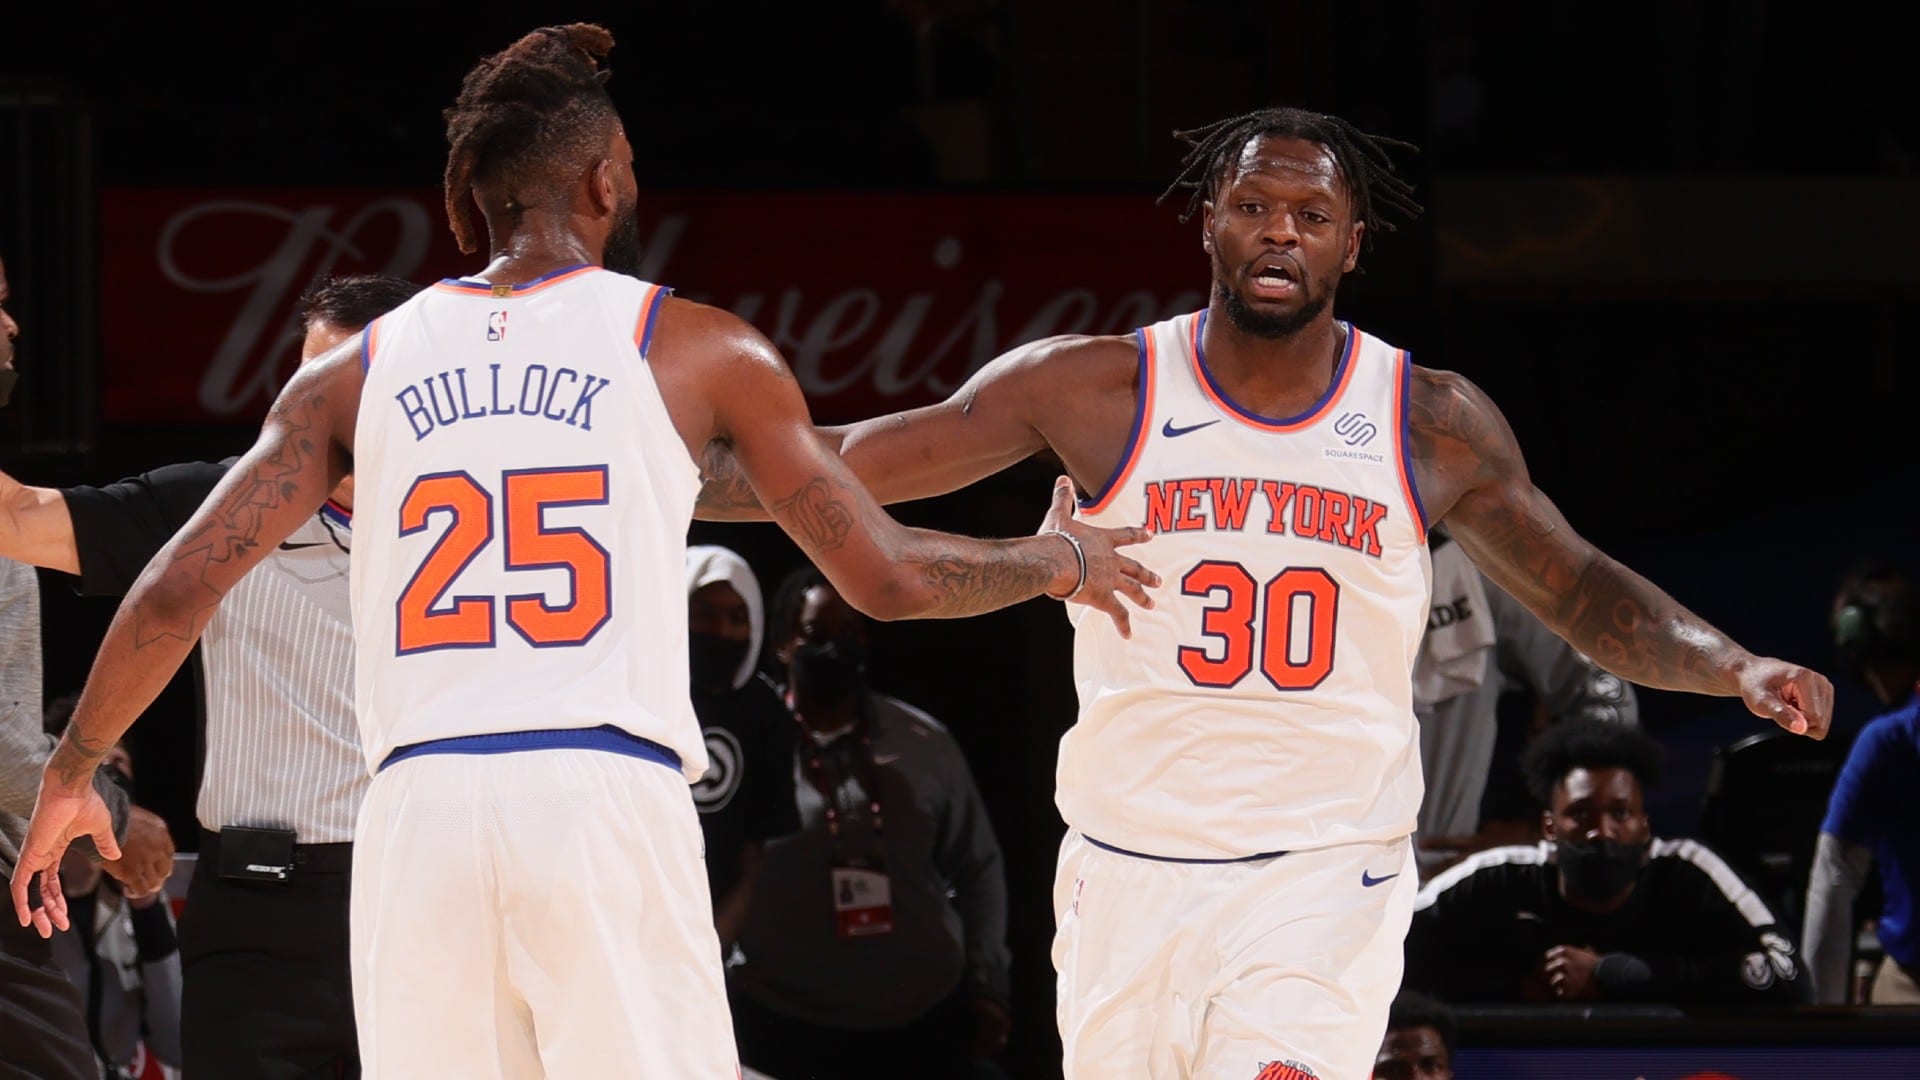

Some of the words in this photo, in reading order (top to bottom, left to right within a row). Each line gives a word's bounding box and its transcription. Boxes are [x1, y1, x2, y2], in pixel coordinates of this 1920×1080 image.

[395, 363, 609, 441] BULLOCK
[1324, 448, 1384, 463] SQUARESPACE
[1143, 477, 1257, 533] NEW
[1262, 479, 1388, 559] YORK
[396, 464, 611, 655] 25
[1177, 559, 1340, 691] 30
[1428, 595, 1472, 631] DE
